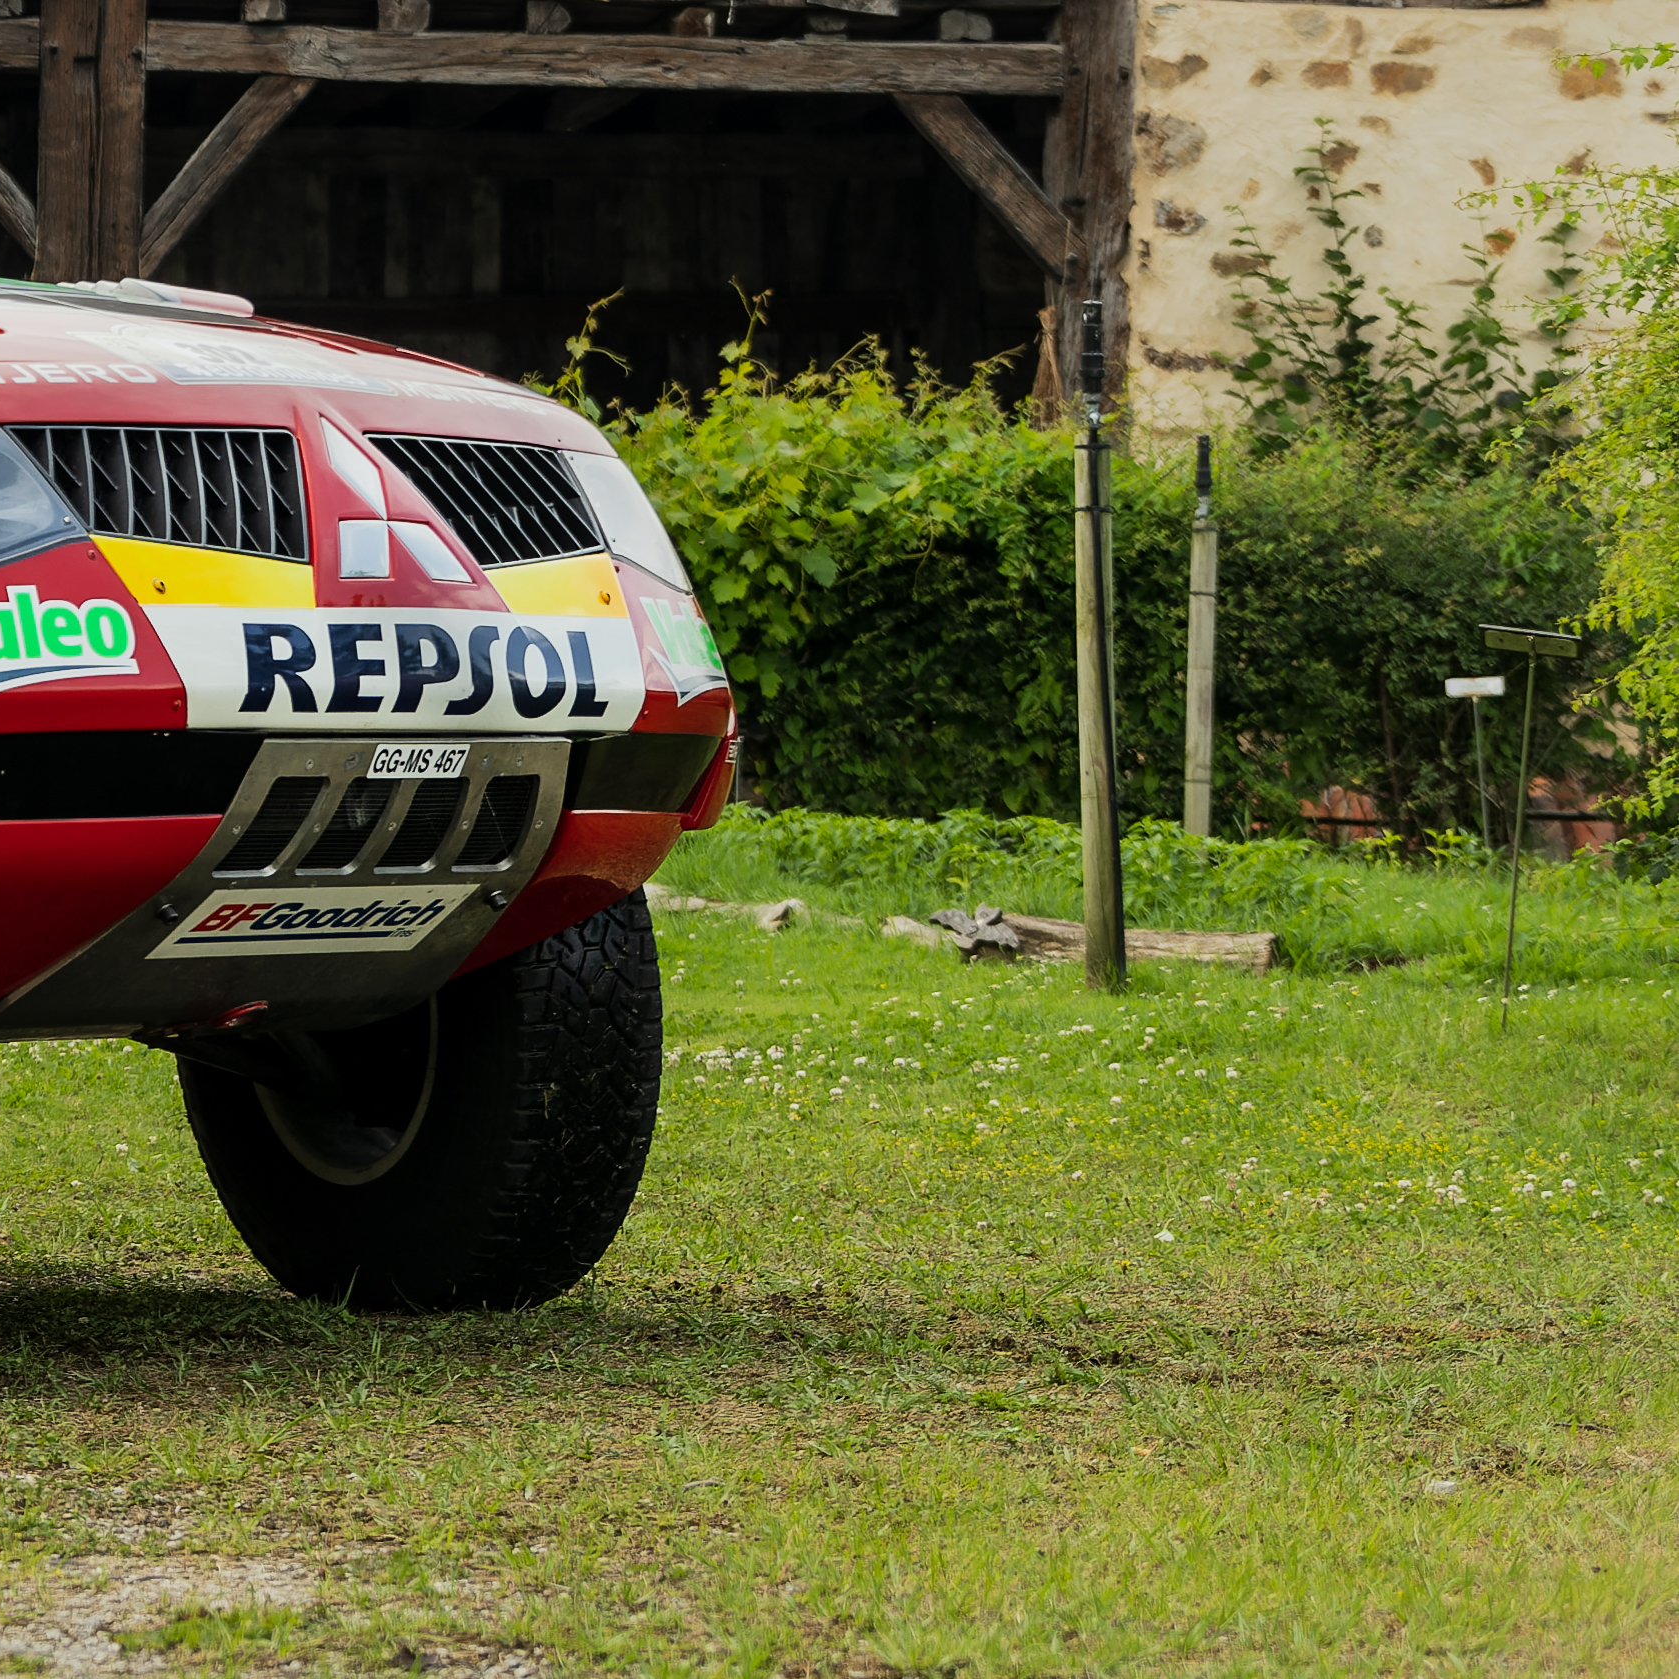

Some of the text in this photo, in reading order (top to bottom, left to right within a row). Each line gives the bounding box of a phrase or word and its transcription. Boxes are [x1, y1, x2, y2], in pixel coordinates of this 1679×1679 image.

[238, 622, 611, 719] REPSOL
[372, 749, 467, 774] GG-MS 467
[189, 898, 446, 933] BFGoodrich
